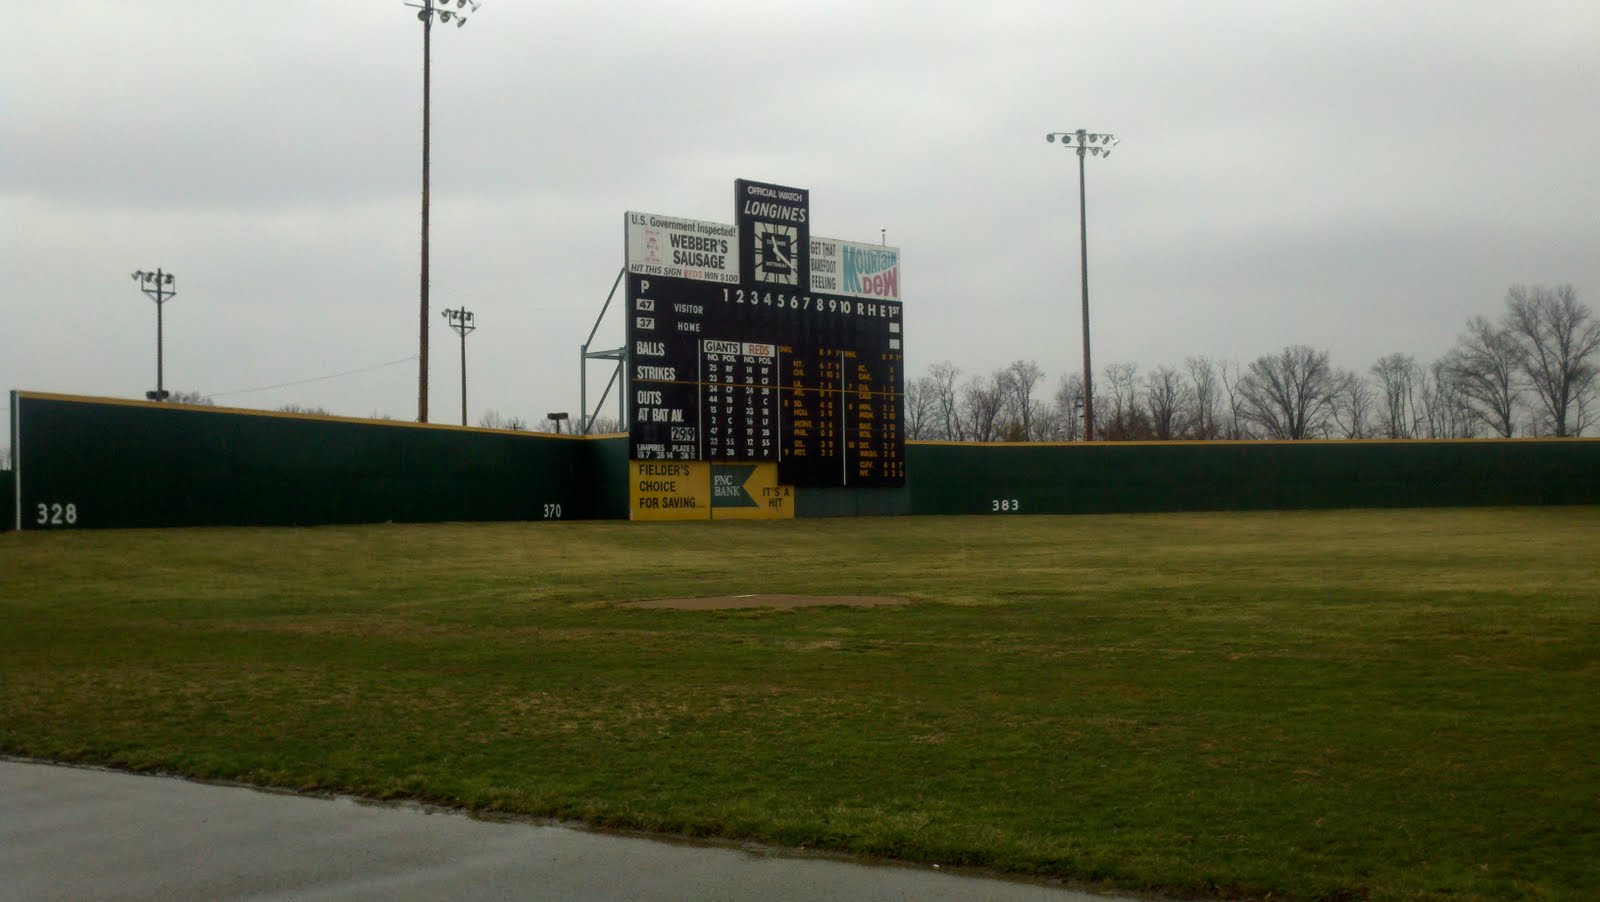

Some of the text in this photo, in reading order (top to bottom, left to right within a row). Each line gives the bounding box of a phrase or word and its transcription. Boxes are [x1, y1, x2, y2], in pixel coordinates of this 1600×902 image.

[748, 186, 802, 202] OFFICIAL WATCH
[744, 200, 806, 222] LONGINES
[631, 214, 736, 237] U.S. Government Inspected!
[670, 233, 728, 254] WEBBER'S
[811, 241, 836, 256] GET THAT
[673, 250, 725, 270] SAUSAGE
[811, 258, 836, 273] BAREFOOT
[631, 264, 738, 282] HIT THIS SIGN REDS WIN $100
[640, 280, 650, 294] P
[812, 274, 836, 290] FEELING
[640, 300, 652, 309] 47
[674, 303, 704, 314] VISITOR
[723, 288, 900, 318] 1 2 3 4 5 6 7 8 9 10 R H E 1ST
[640, 319, 652, 327] 37
[677, 321, 700, 332] HOME
[637, 341, 665, 356] BALLS
[706, 341, 738, 353] GIANTS
[749, 345, 769, 356] REDS
[637, 366, 675, 380] STRIKES
[637, 390, 662, 405] OUTS
[638, 407, 684, 422] AT BAT AV.
[672, 427, 694, 440] 299
[637, 444, 665, 452] UMPIRES
[639, 464, 690, 476] FIELDER'S
[639, 481, 676, 492] CHOICE
[714, 475, 733, 485] PNC
[714, 486, 740, 497] BANK
[763, 487, 790, 497] IT'S A
[639, 498, 659, 508] FOR
[769, 498, 783, 508] HIT
[992, 500, 1019, 511] 383
[37, 503, 78, 524] 328
[544, 504, 561, 518] 370
